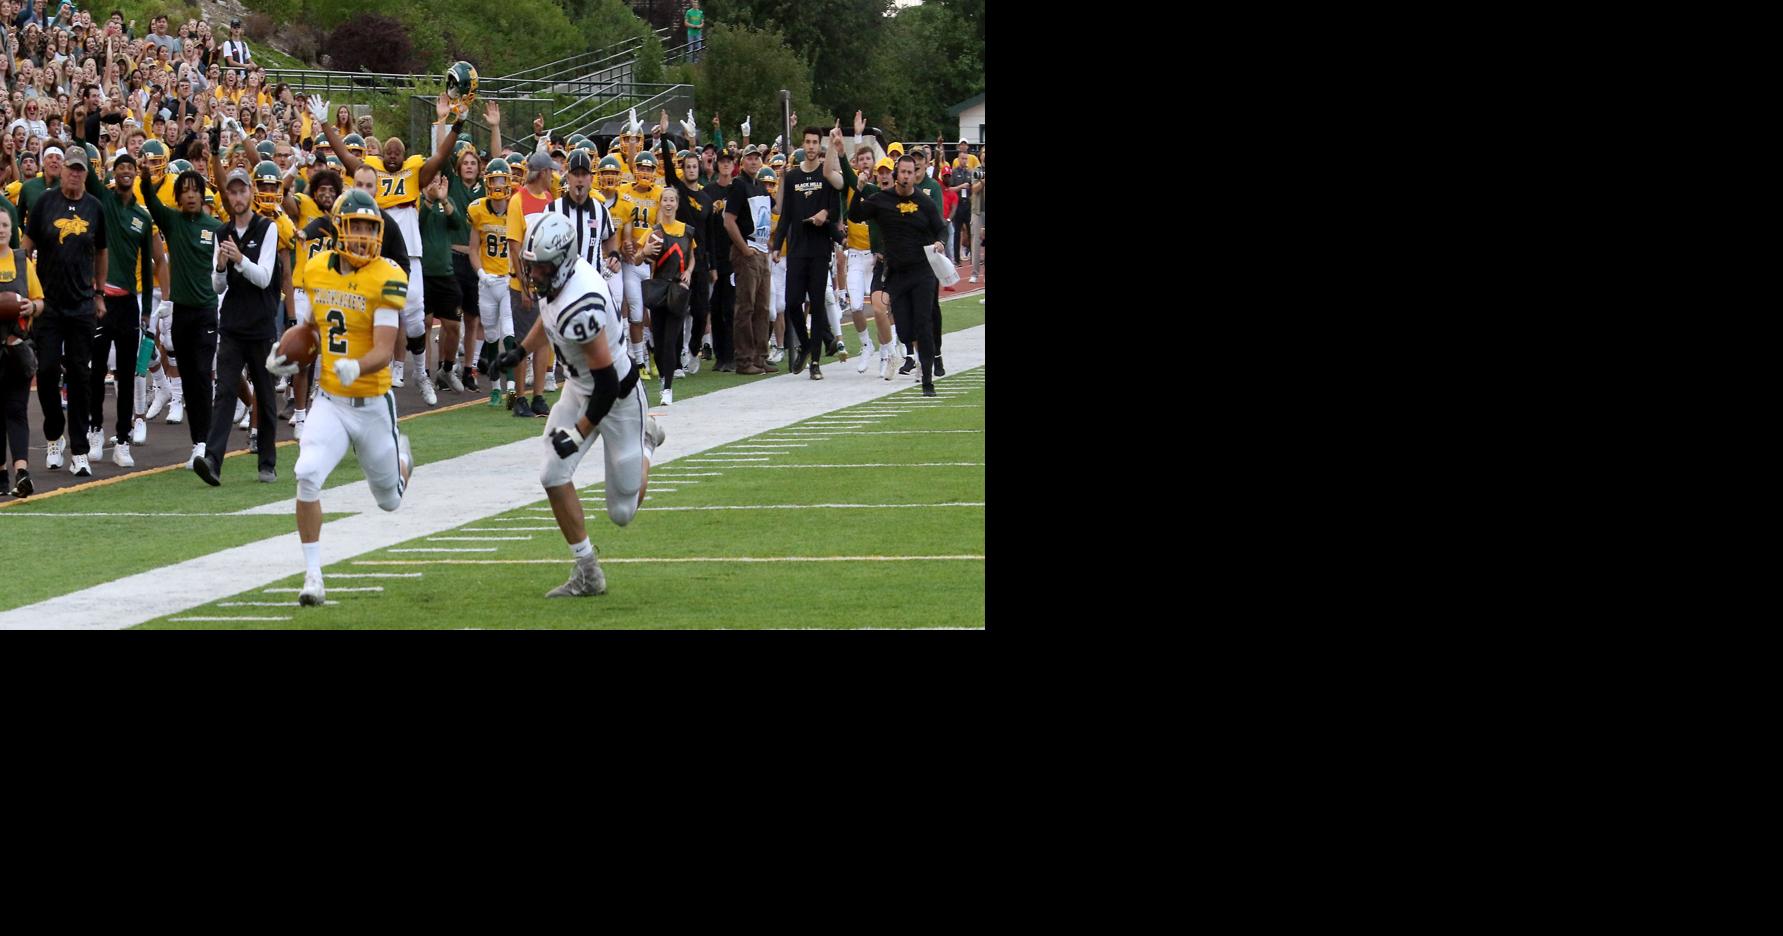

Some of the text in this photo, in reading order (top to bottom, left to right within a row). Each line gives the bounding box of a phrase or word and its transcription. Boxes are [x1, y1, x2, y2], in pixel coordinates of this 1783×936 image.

[381, 177, 406, 197] 74
[326, 308, 348, 355] 2
[573, 314, 601, 341] 94
